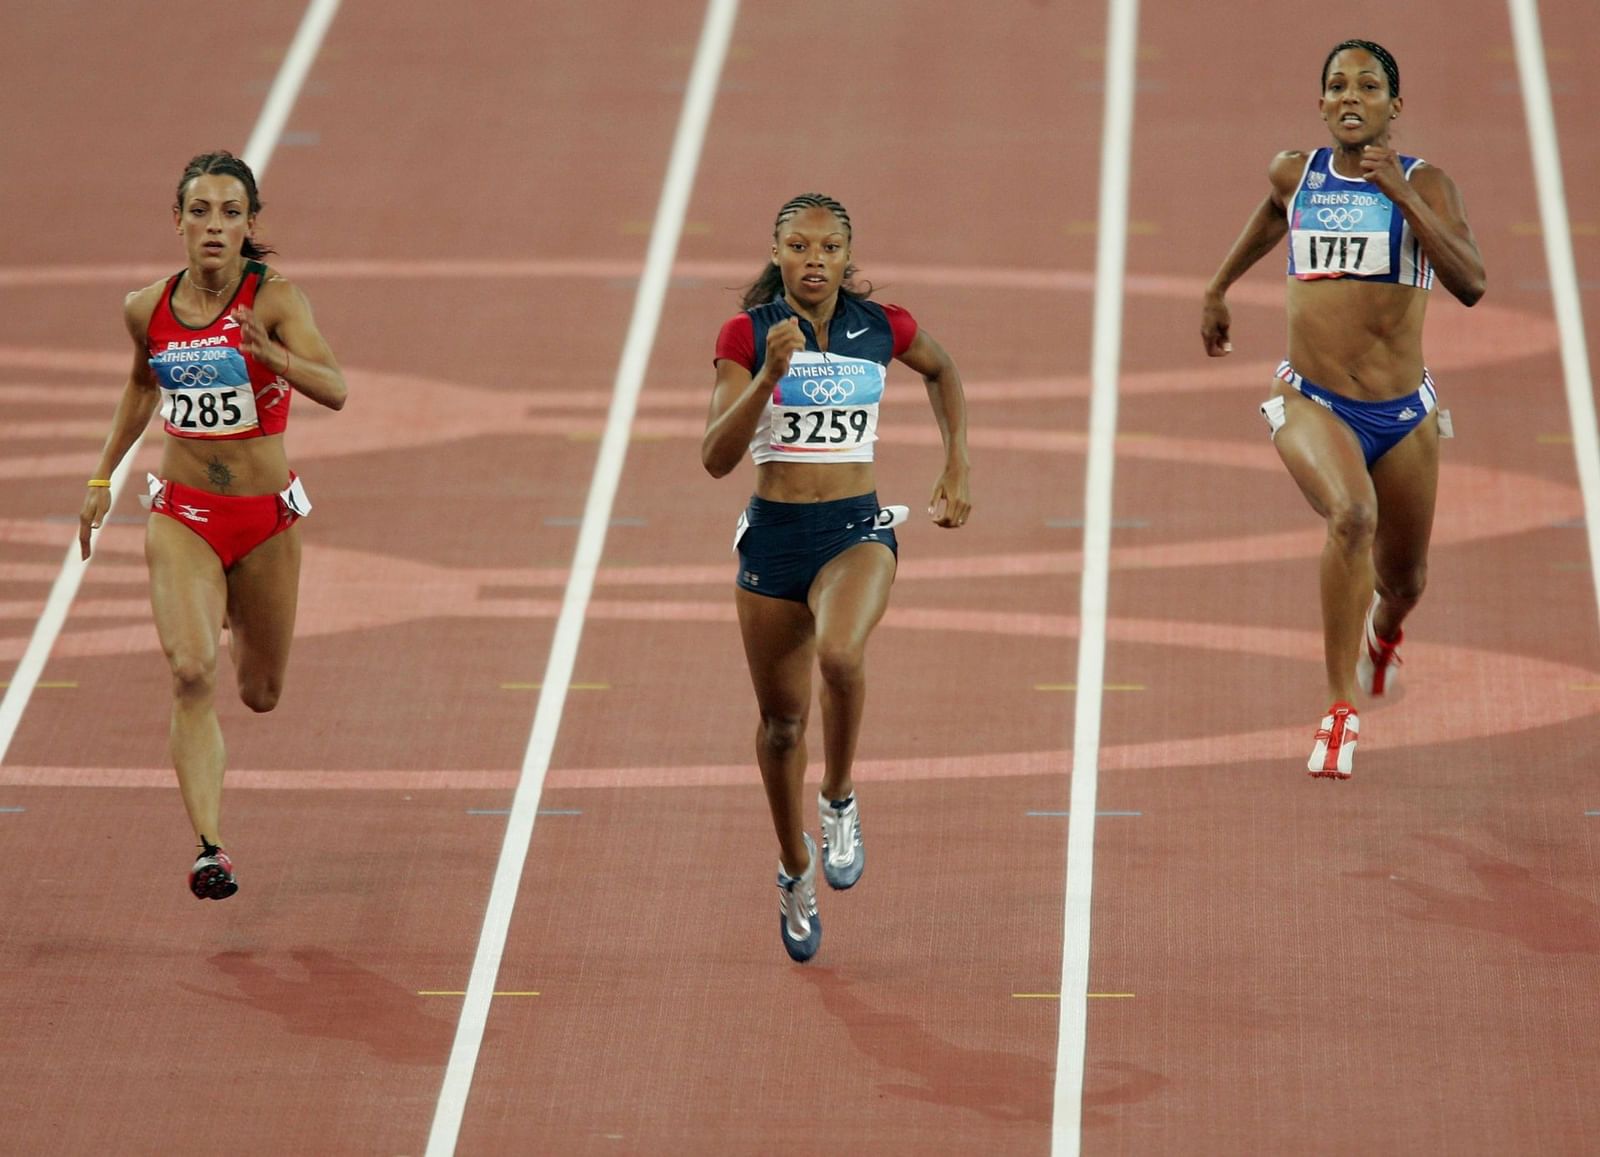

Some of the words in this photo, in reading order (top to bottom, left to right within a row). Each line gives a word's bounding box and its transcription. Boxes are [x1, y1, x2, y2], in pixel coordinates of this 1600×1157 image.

[1310, 193, 1350, 205] ATHENS
[1310, 236, 1369, 270] 1717
[167, 335, 228, 350] BULGARIA
[161, 351, 200, 362] ATHENS
[201, 350, 227, 361] 2004
[788, 365, 834, 377] ATHENS
[838, 364, 865, 375] 2004
[170, 391, 241, 428] 1285
[781, 410, 868, 443] 3259
